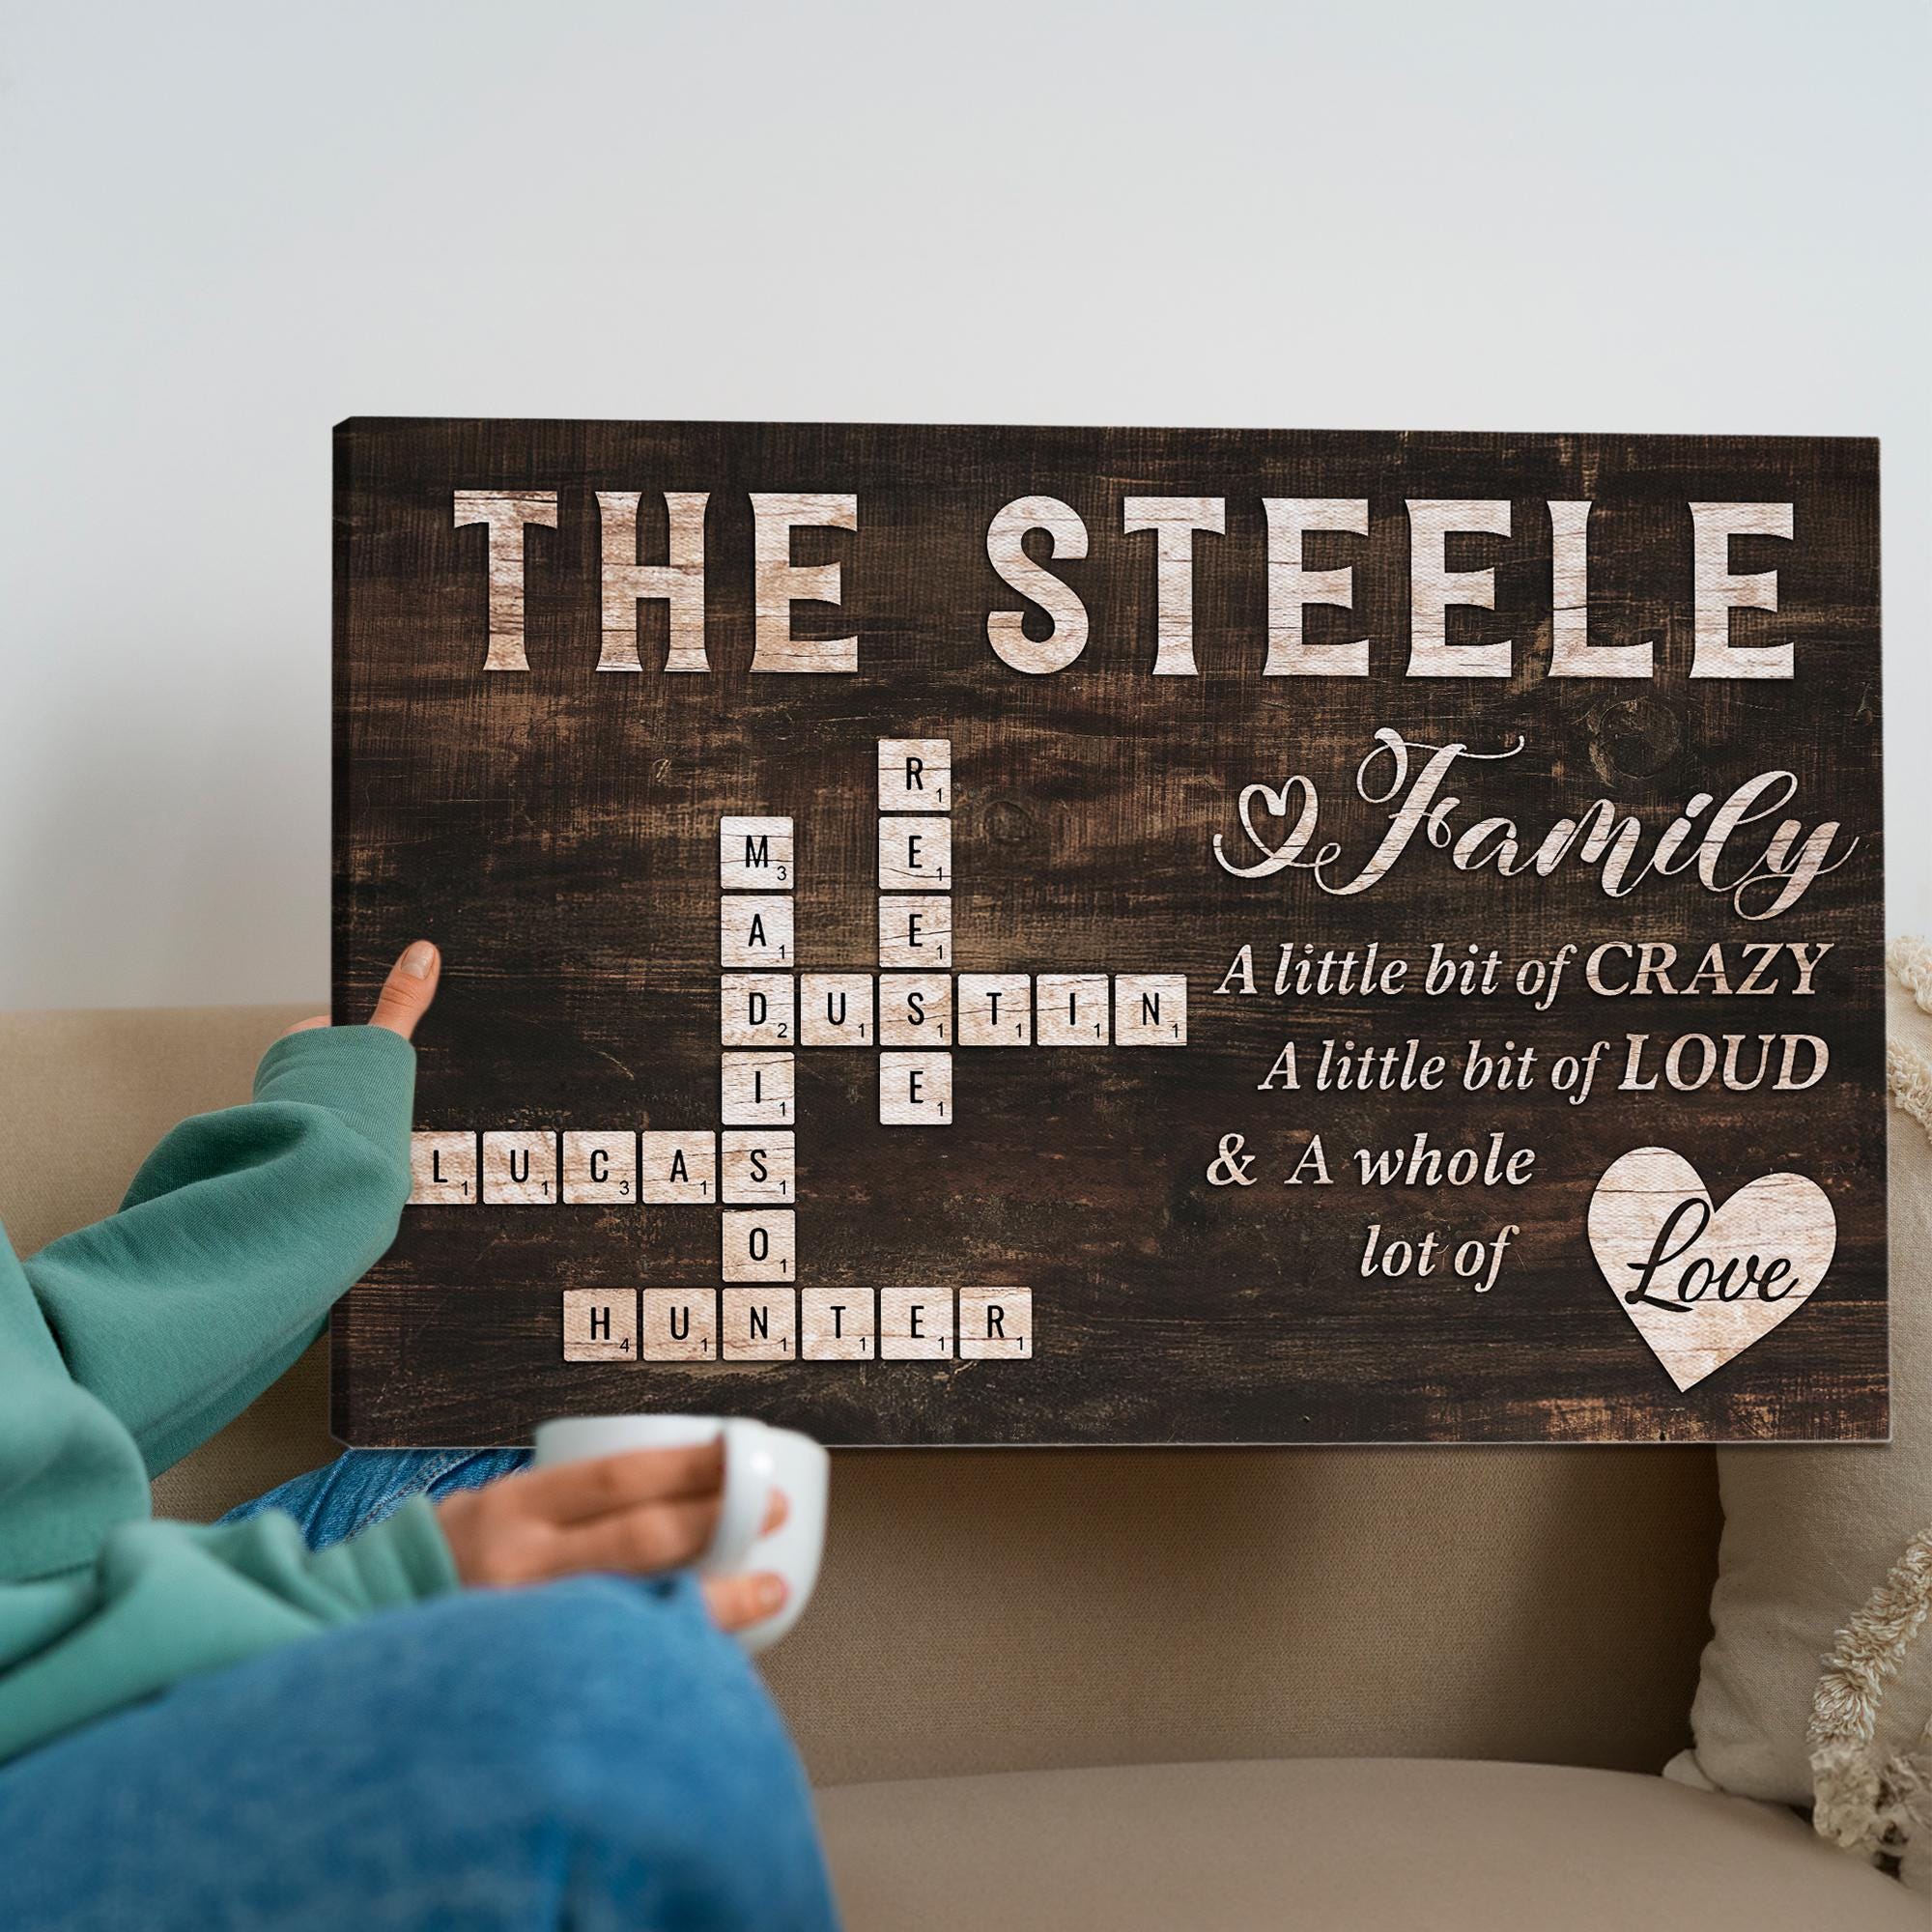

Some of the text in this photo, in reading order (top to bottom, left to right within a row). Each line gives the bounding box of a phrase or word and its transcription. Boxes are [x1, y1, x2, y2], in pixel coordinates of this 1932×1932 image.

[454, 490, 1795, 679] THE STEELE
[934, 787, 942, 803] 1
[1313, 726, 1860, 921] Family
[778, 866, 786, 880] 3
[935, 867, 943, 881] 1
[905, 756, 925, 1104] REESE
[778, 944, 785, 959] 1
[935, 944, 943, 959] 1
[1212, 941, 1834, 1010] A little bit of CRAZY
[749, 992, 1160, 1026] DUSTIN
[778, 1023, 787, 1037] 2
[857, 1022, 865, 1037] 1
[936, 1022, 944, 1037] 1
[1014, 1023, 1022, 1037] 1
[1093, 1022, 1100, 1037] 1
[1171, 1023, 1179, 1037] 1
[1257, 1033, 1830, 1105] A little bit of LOUD
[745, 835, 773, 1341] MADISON
[779, 1101, 786, 1116] 1
[936, 1100, 944, 1116] 1
[433, 1149, 768, 1183] LUCAS
[1207, 1132, 1536, 1186] & A whole
[461, 1179, 469, 1196] 1
[542, 1179, 550, 1195] 1
[620, 1180, 629, 1195] 3
[699, 1179, 707, 1195] 1
[779, 1179, 786, 1194] 1
[1360, 1224, 1520, 1293] lot of
[1624, 1197, 1800, 1314] Love
[780, 1258, 787, 1273] 1
[590, 1305, 1005, 1341] HUNTER
[619, 1338, 629, 1352] 4
[700, 1337, 708, 1351] 1
[779, 1338, 786, 1351] 1
[858, 1336, 866, 1350] 1
[937, 1336, 945, 1350] 1
[1015, 1336, 1023, 1350] 1
